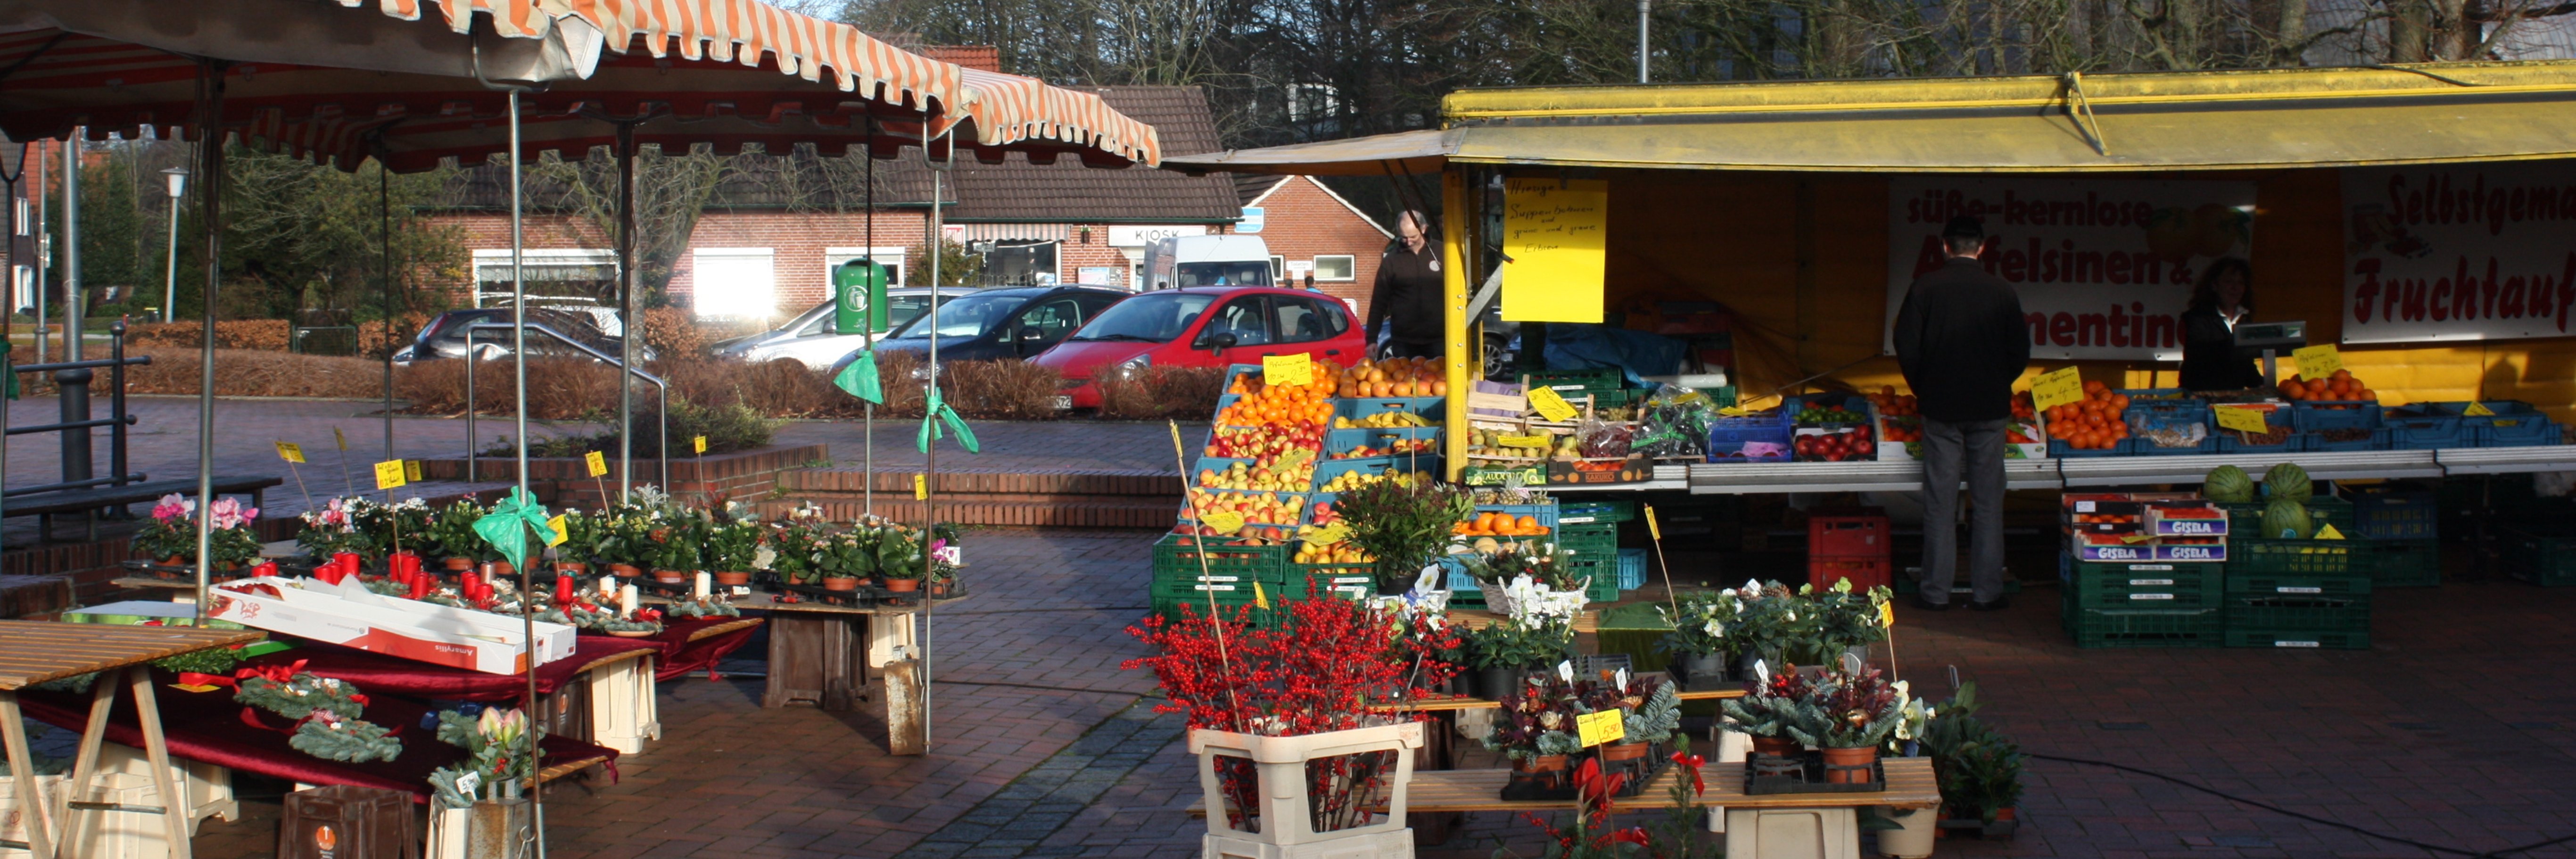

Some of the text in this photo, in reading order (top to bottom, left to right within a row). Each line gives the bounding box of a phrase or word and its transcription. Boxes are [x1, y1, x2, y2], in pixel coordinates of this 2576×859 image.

[1135, 230, 1179, 240] KIOSK
[1546, 225, 1563, 233] und
[1913, 234, 2192, 285] Afelsinen &
[1585, 473, 1615, 481] KAKUKO
[2172, 521, 2212, 533] GISELA
[2098, 547, 2210, 559] GISELA GISELA
[435, 644, 473, 656] Amaryllis
